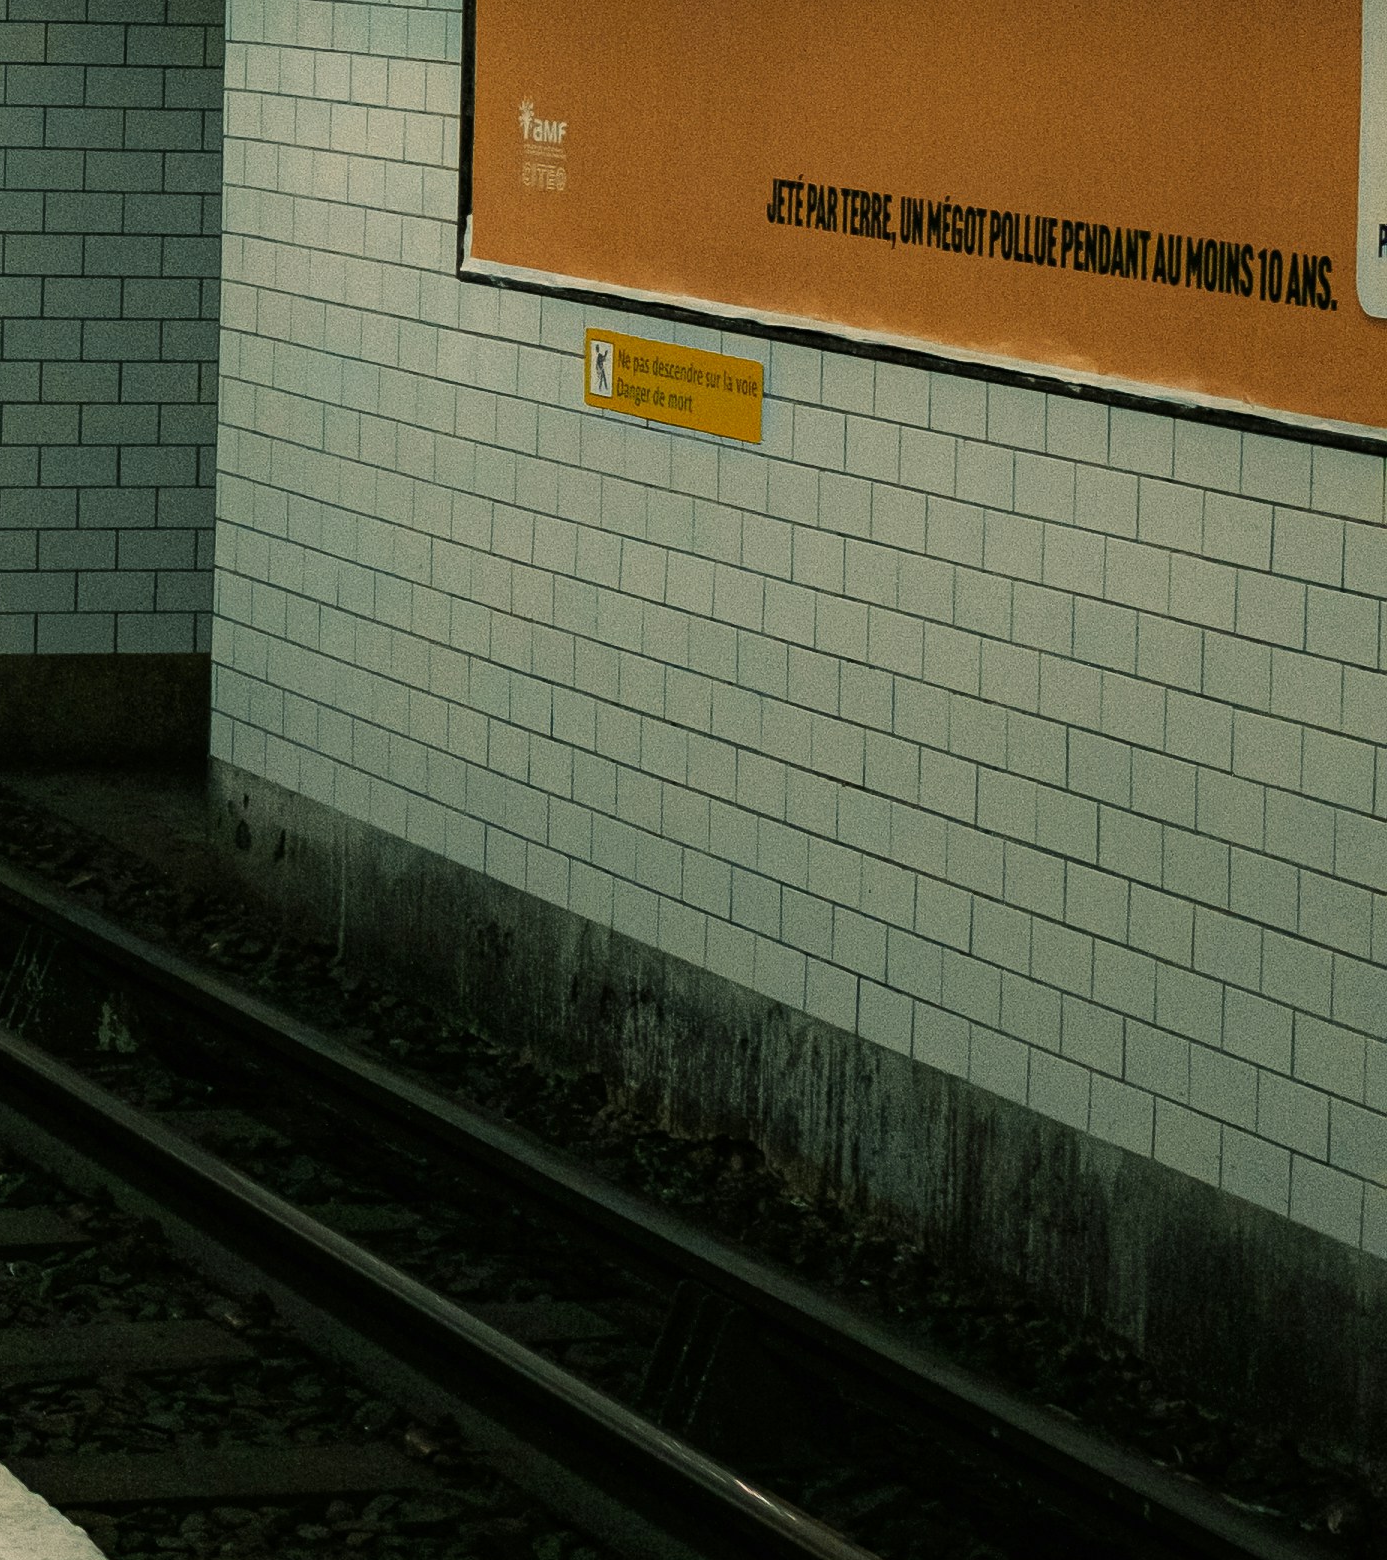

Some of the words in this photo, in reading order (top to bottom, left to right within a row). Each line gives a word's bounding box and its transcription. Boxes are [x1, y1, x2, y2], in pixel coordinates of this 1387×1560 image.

[766, 174, 804, 227] JETÉ
[806, 183, 838, 232] PAR
[840, 187, 897, 250] TERRE,
[899, 196, 924, 246] UN
[927, 195, 987, 257] MÉGOT
[989, 209, 1058, 268] POLLUE
[1060, 219, 1151, 282] PENDANT
[1151, 232, 1182, 286] AU
[1185, 236, 1255, 298] MOINS
[1257, 247, 1284, 304] 10
[1284, 252, 1338, 312] ANS.
[617, 377, 650, 406] Danger
[652, 388, 665, 407] de
[667, 394, 693, 413] mort
[618, 349, 631, 370] Ne
[633, 356, 650, 374] pas
[652, 356, 704, 386] descendre
[705, 370, 721, 388] sur
[723, 370, 733, 392] la
[736, 375, 758, 398] voie
